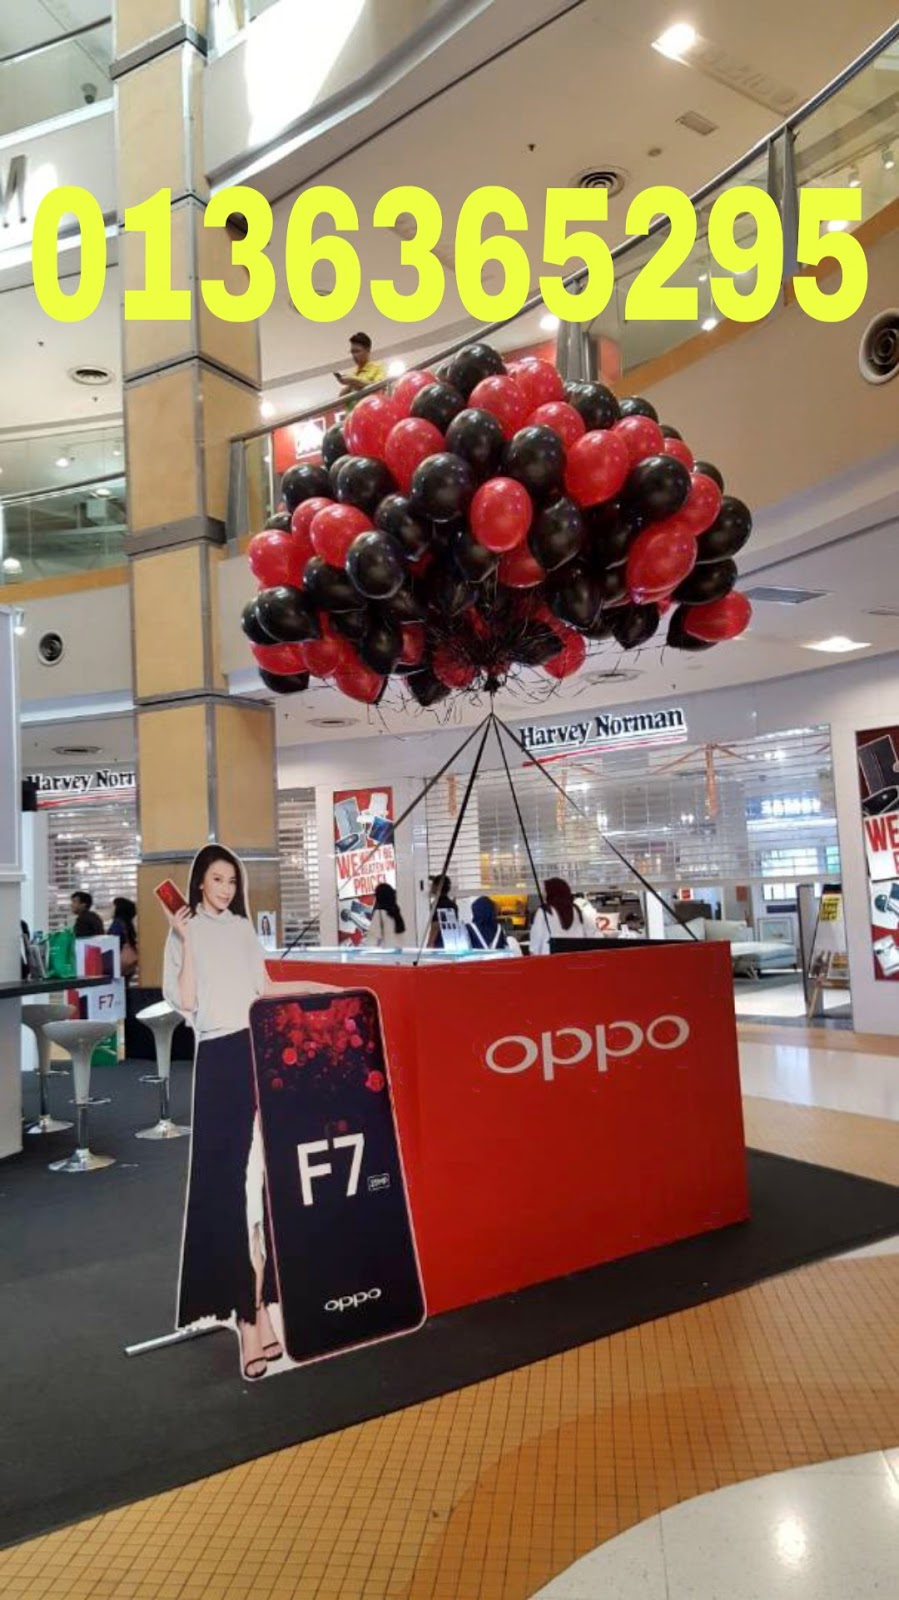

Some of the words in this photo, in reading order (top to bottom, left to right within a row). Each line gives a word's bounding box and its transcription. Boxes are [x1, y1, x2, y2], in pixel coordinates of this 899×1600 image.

[518, 721, 591, 748] Harvey
[594, 708, 684, 737] Norman
[864, 814, 899, 852] WE
[337, 852, 361, 879] WE
[98, 994, 115, 1010] F7
[297, 1132, 365, 1206] F7
